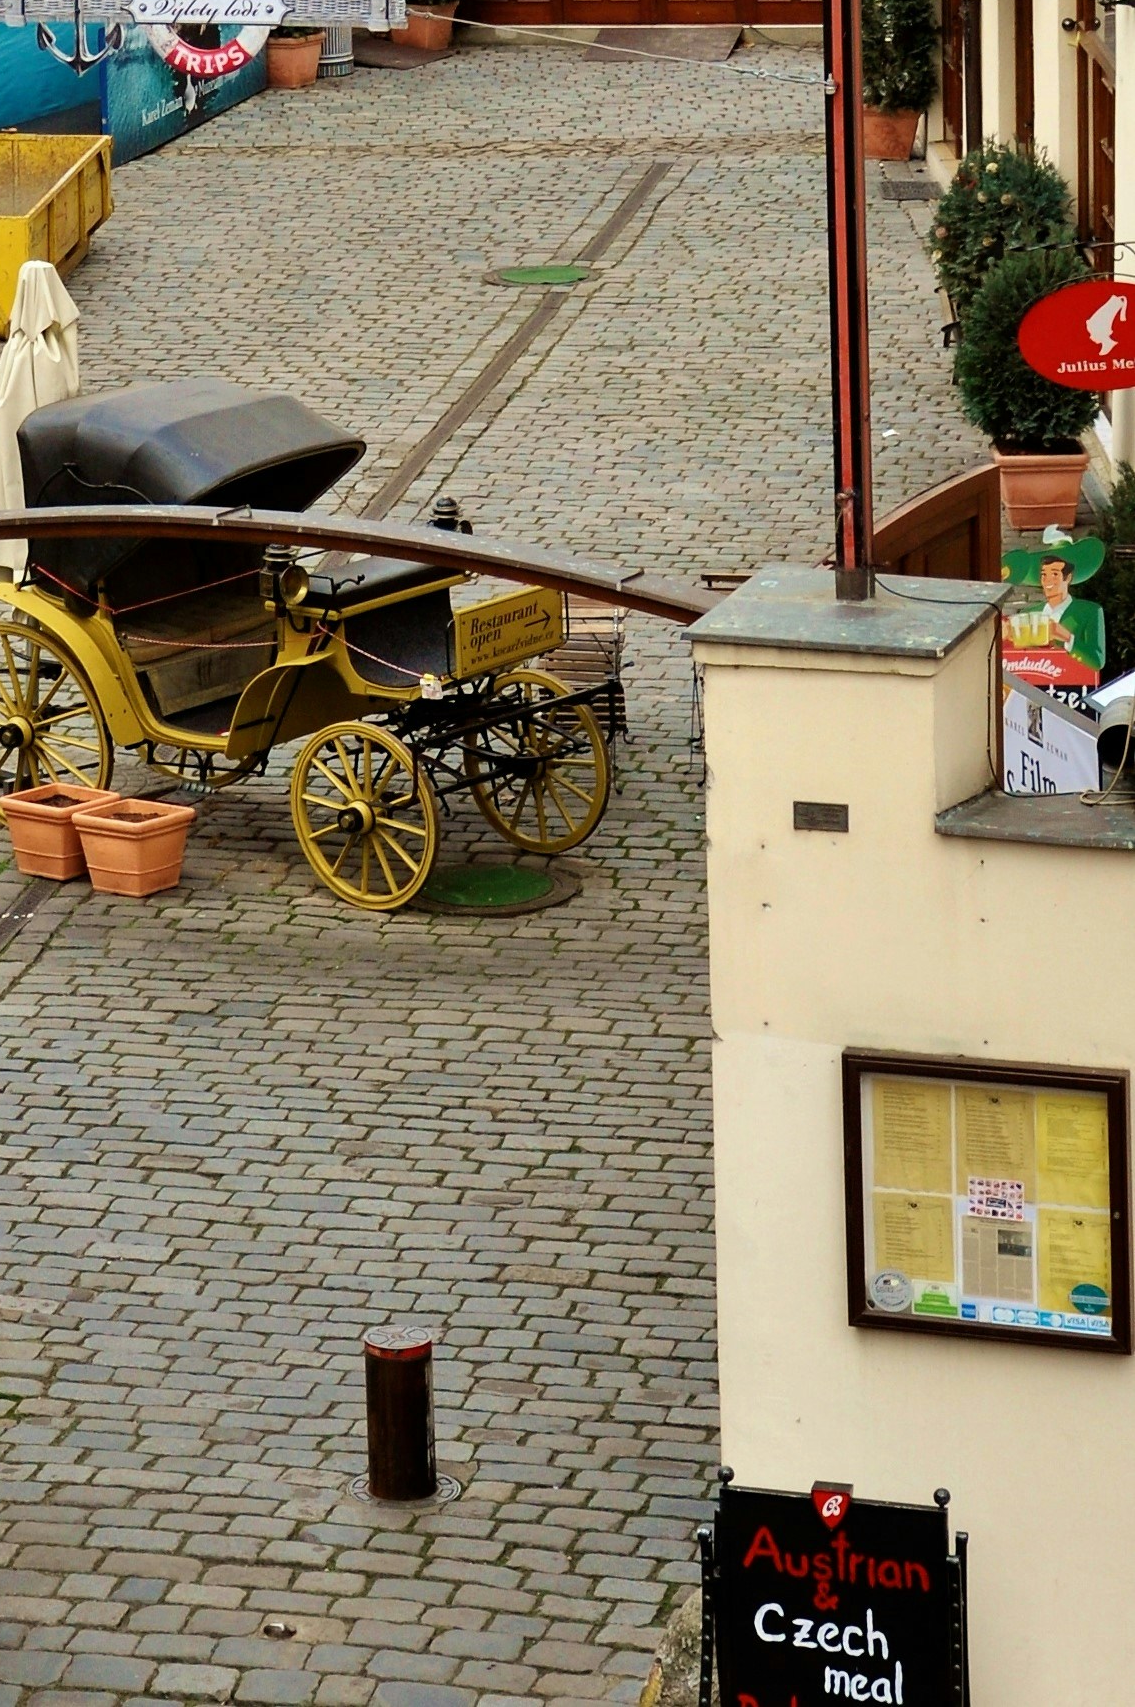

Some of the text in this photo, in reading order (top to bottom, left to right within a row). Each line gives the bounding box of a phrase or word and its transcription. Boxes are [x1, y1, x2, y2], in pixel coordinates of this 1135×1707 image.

[173, 45, 246, 75] TRIPS
[1057, 358, 1135, 374] Julius Me
[470, 599, 539, 636] Restaurant
[470, 628, 502, 652] open
[1002, 656, 1063, 678] lmdudler
[1045, 683, 1088, 711] tze!
[1020, 749, 1057, 794] Film
[742, 1524, 930, 1592] Austrian
[813, 1581, 840, 1611] &
[753, 1602, 889, 1660] Czech
[824, 1660, 904, 1706] meal
